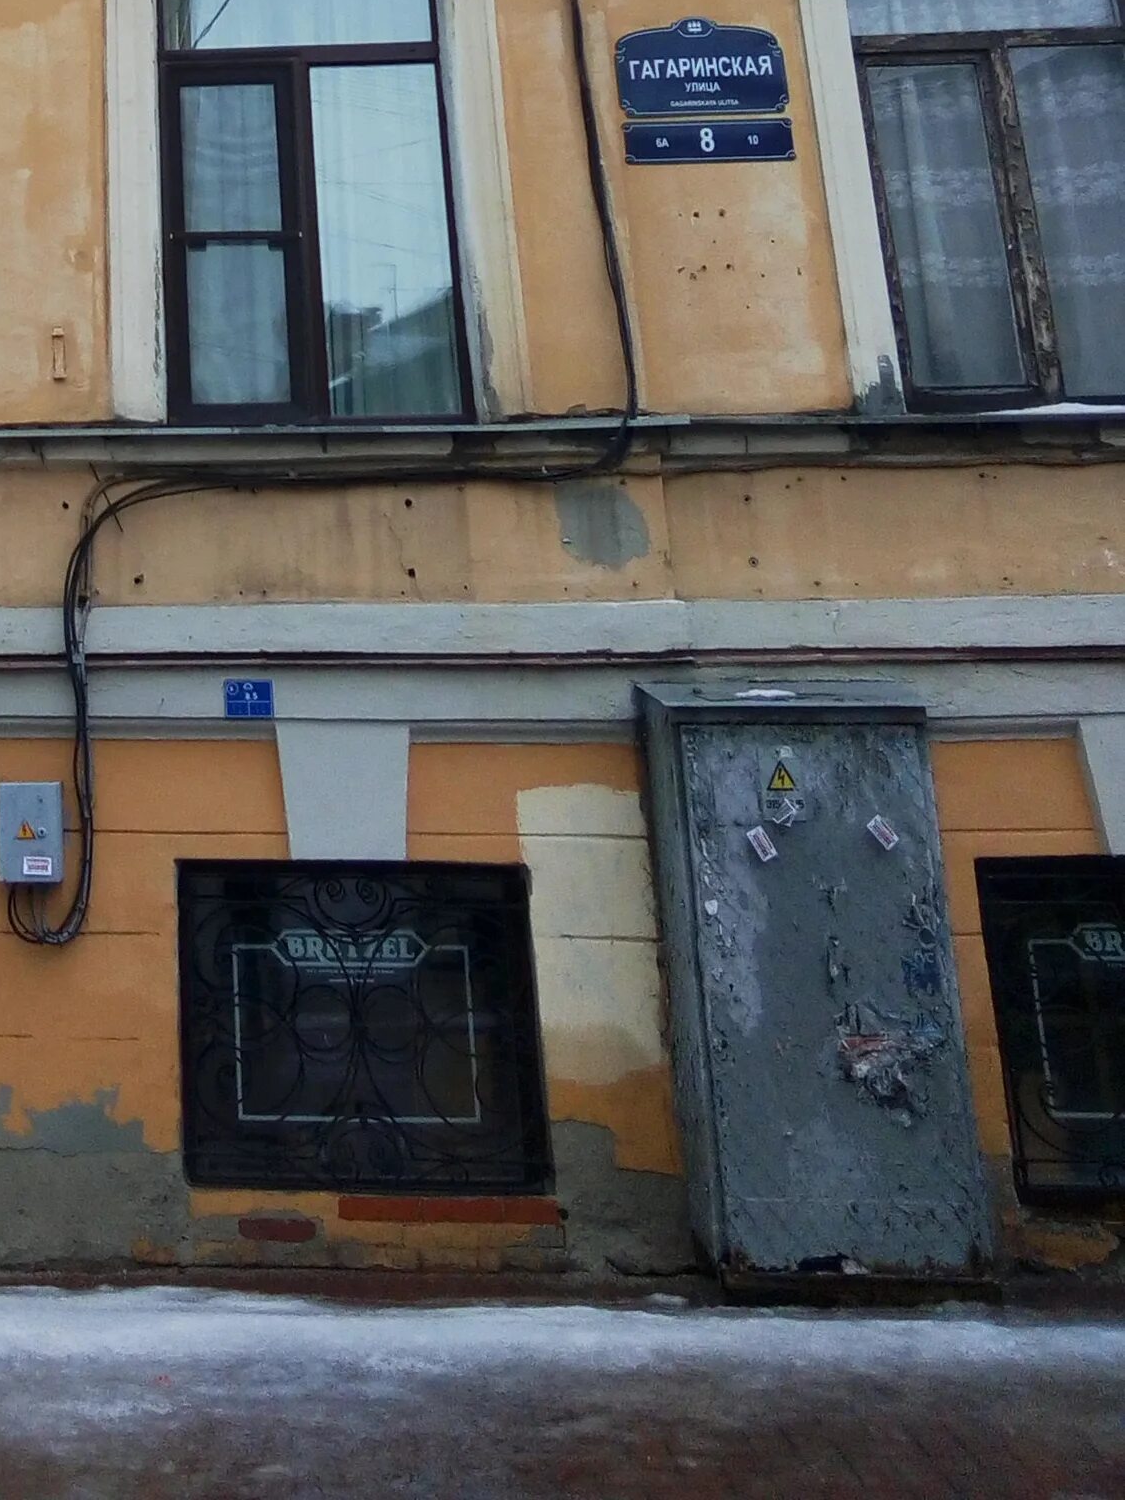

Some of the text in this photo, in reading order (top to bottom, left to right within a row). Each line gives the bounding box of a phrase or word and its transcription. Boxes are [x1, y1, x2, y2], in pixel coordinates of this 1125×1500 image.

[629, 55, 773, 80] ГАГАРИНСКАЯ
[684, 81, 721, 94] УЛИЦА
[700, 127, 715, 152] 8
[747, 135, 759, 145] 10
[285, 936, 415, 959] BRETZEL
[1082, 930, 1125, 952] BR
